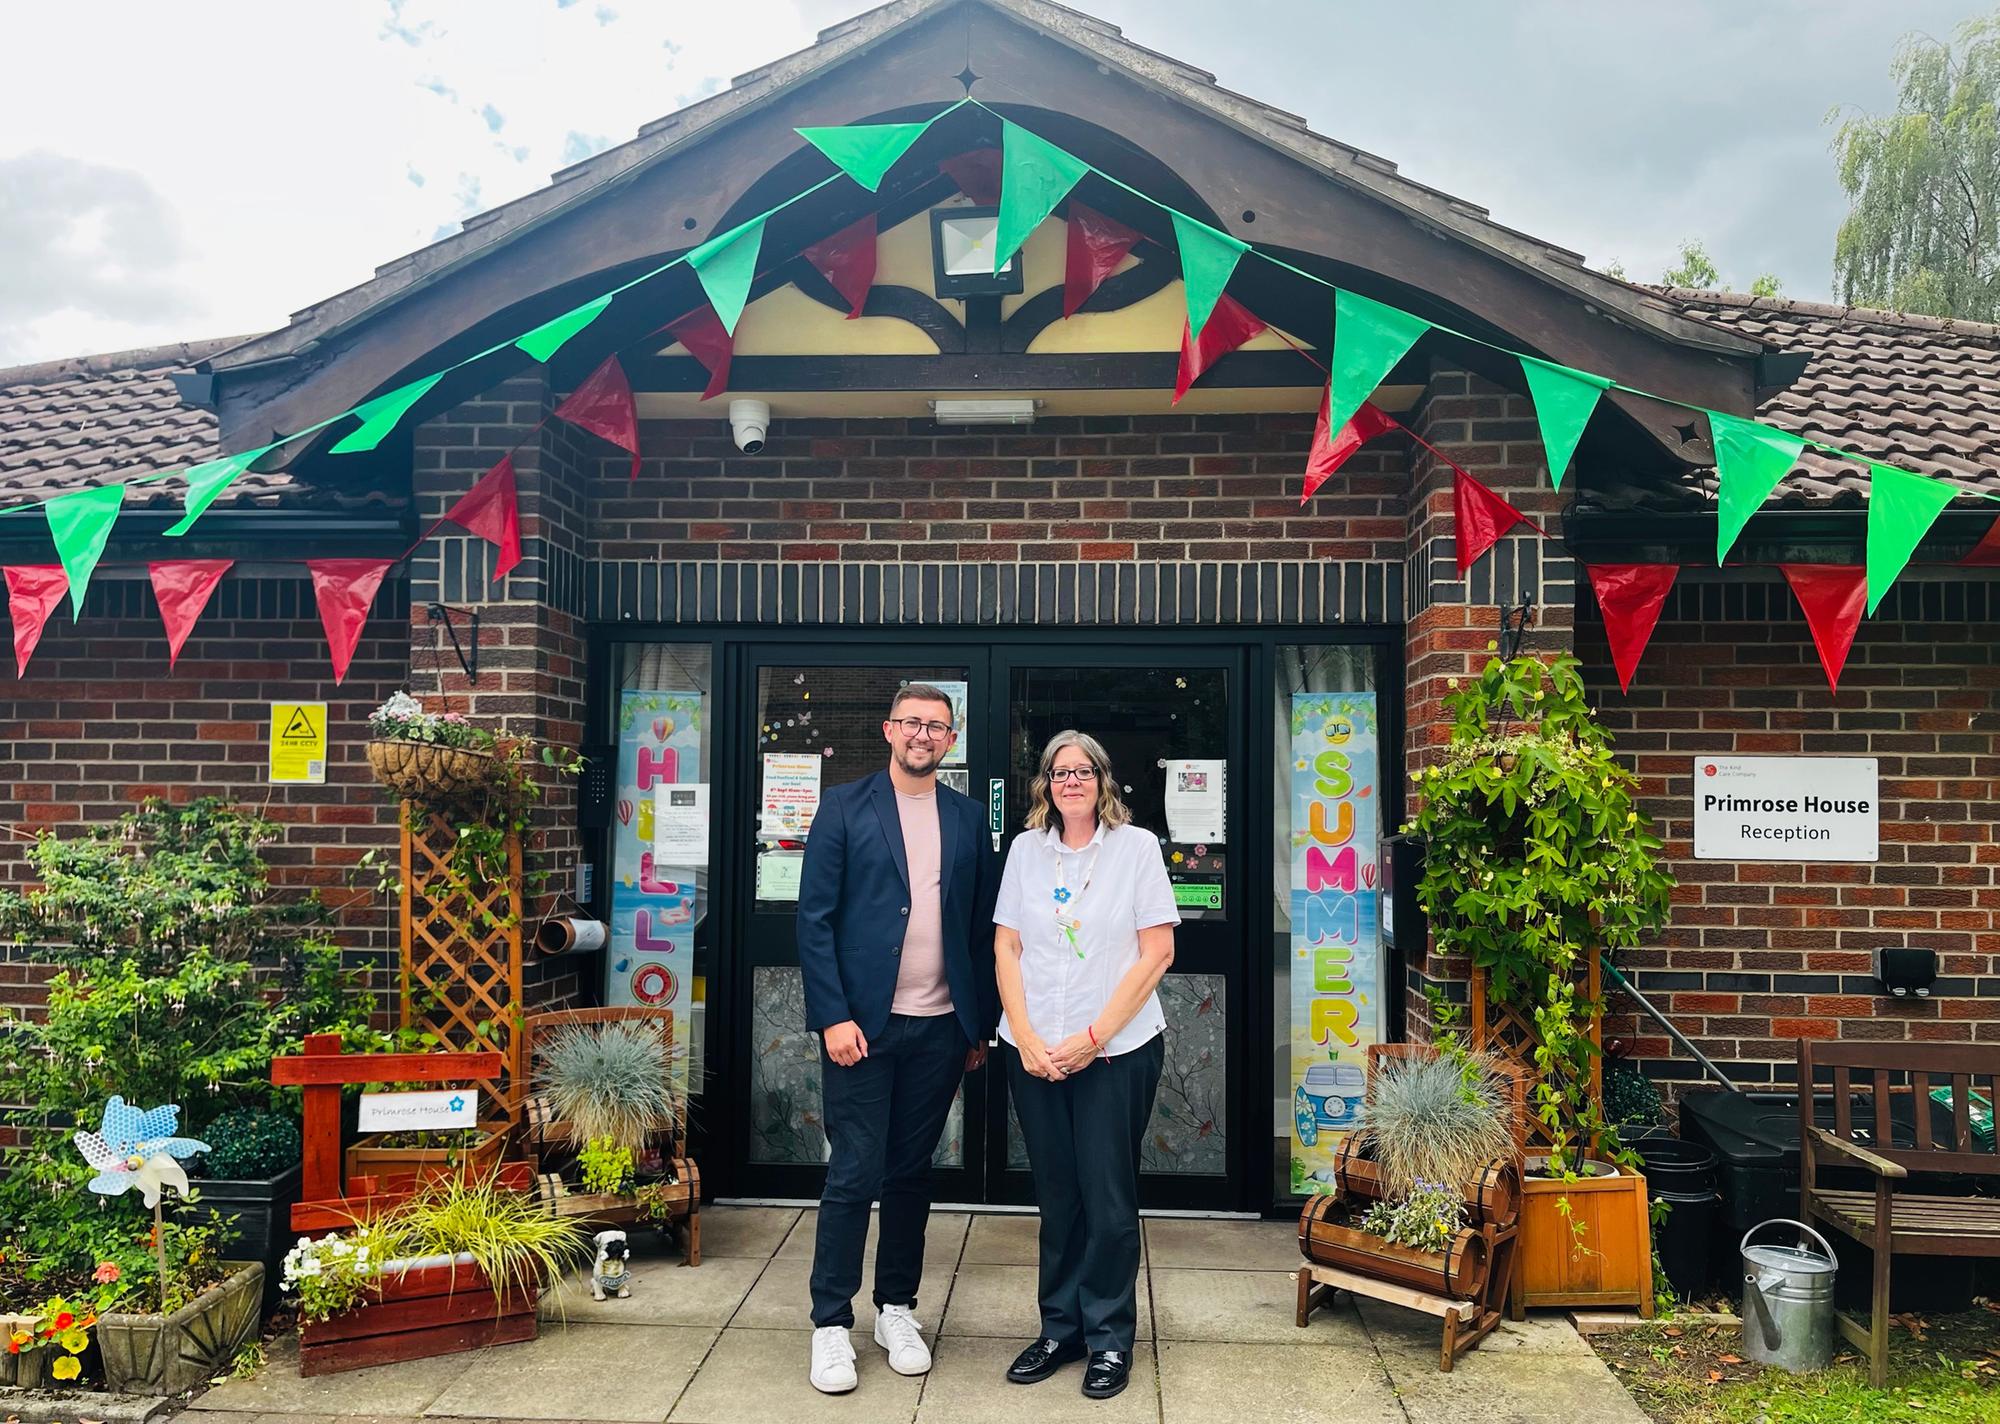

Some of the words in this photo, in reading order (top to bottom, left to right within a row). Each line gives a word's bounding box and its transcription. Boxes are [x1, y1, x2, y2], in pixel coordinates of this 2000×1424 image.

[993, 792, 1001, 830] PULL
[1704, 795, 1798, 813] Primrose
[1804, 796, 1870, 814] House
[1741, 824, 1830, 842] Reception
[1305, 749, 1359, 1047] SUMMER
[371, 1106, 417, 1117] Primrose
[419, 1106, 449, 1114] House
